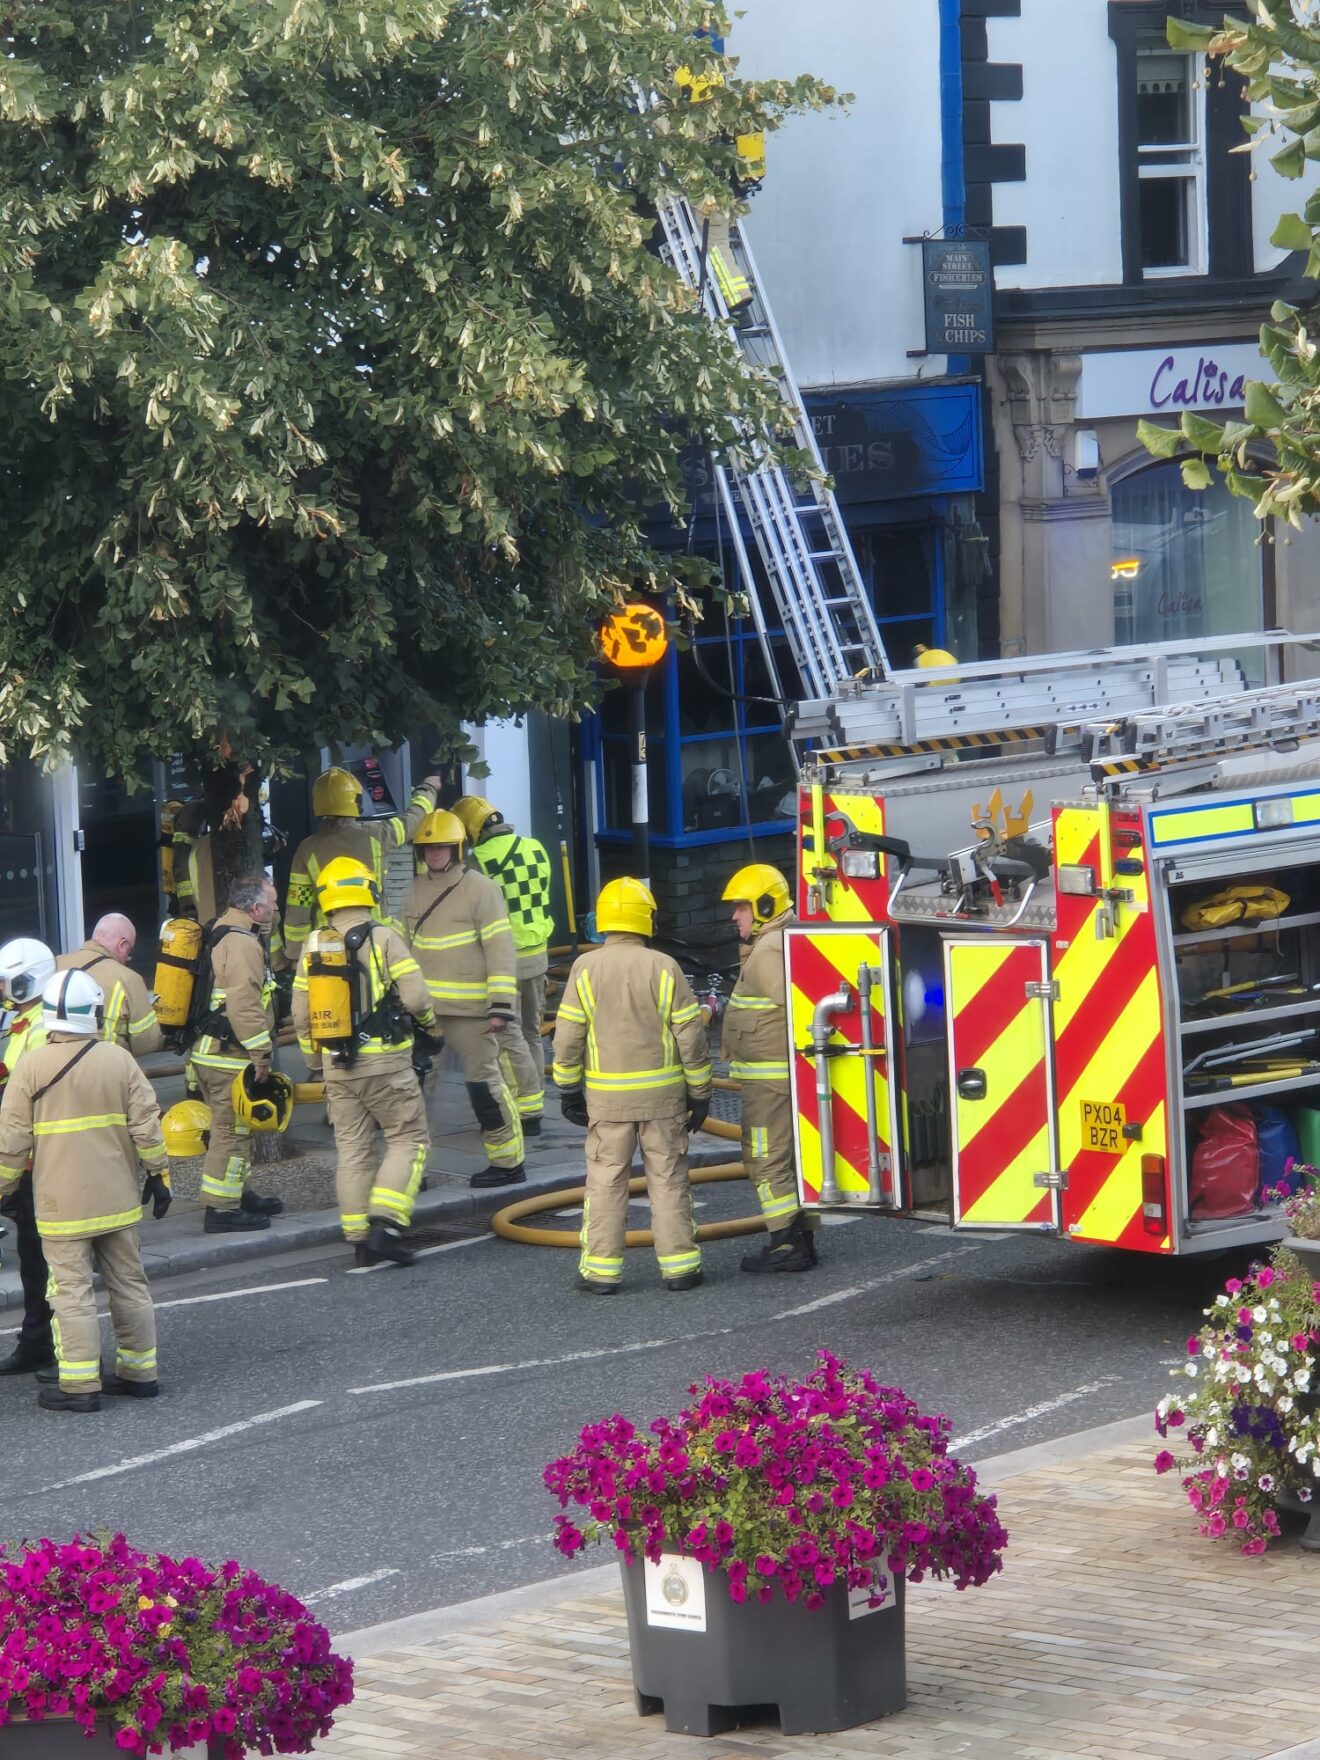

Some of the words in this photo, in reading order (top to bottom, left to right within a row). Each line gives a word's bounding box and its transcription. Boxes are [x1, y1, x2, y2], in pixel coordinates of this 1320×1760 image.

[946, 254, 968, 262] MAIN
[942, 262, 973, 270] STREET
[933, 273, 983, 282] FISHERIES
[944, 313, 975, 327] FISH
[945, 329, 986, 343] CHIPS
[1150, 355, 1246, 408] Calisa
[312, 1010, 332, 1020] AIR
[1084, 1103, 1121, 1126] PX04
[1090, 1126, 1118, 1148] BZR
